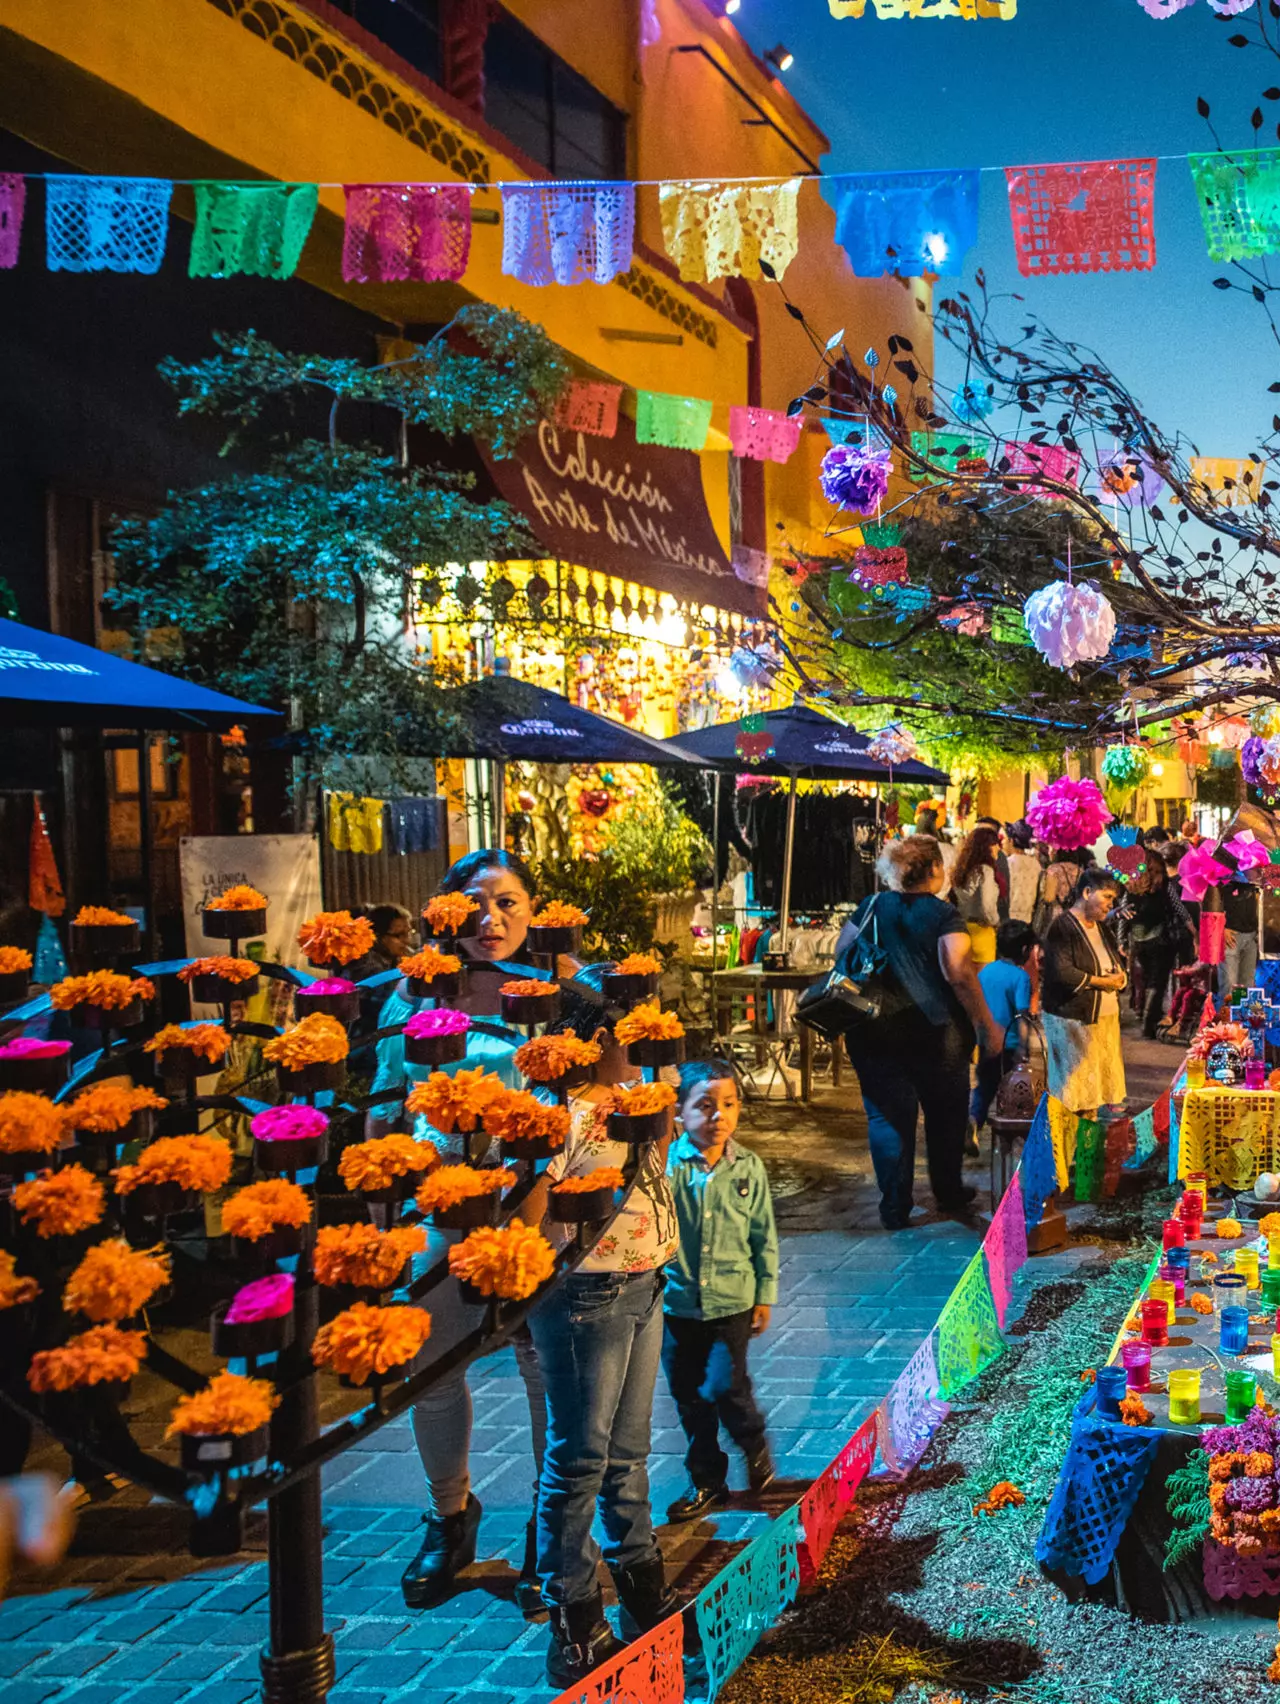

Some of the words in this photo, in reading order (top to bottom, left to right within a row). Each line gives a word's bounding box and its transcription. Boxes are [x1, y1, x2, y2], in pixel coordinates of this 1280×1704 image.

[538, 418, 672, 512] Colección
[522, 465, 599, 533] Arte
[603, 498, 639, 548] de
[629, 505, 734, 578] México
